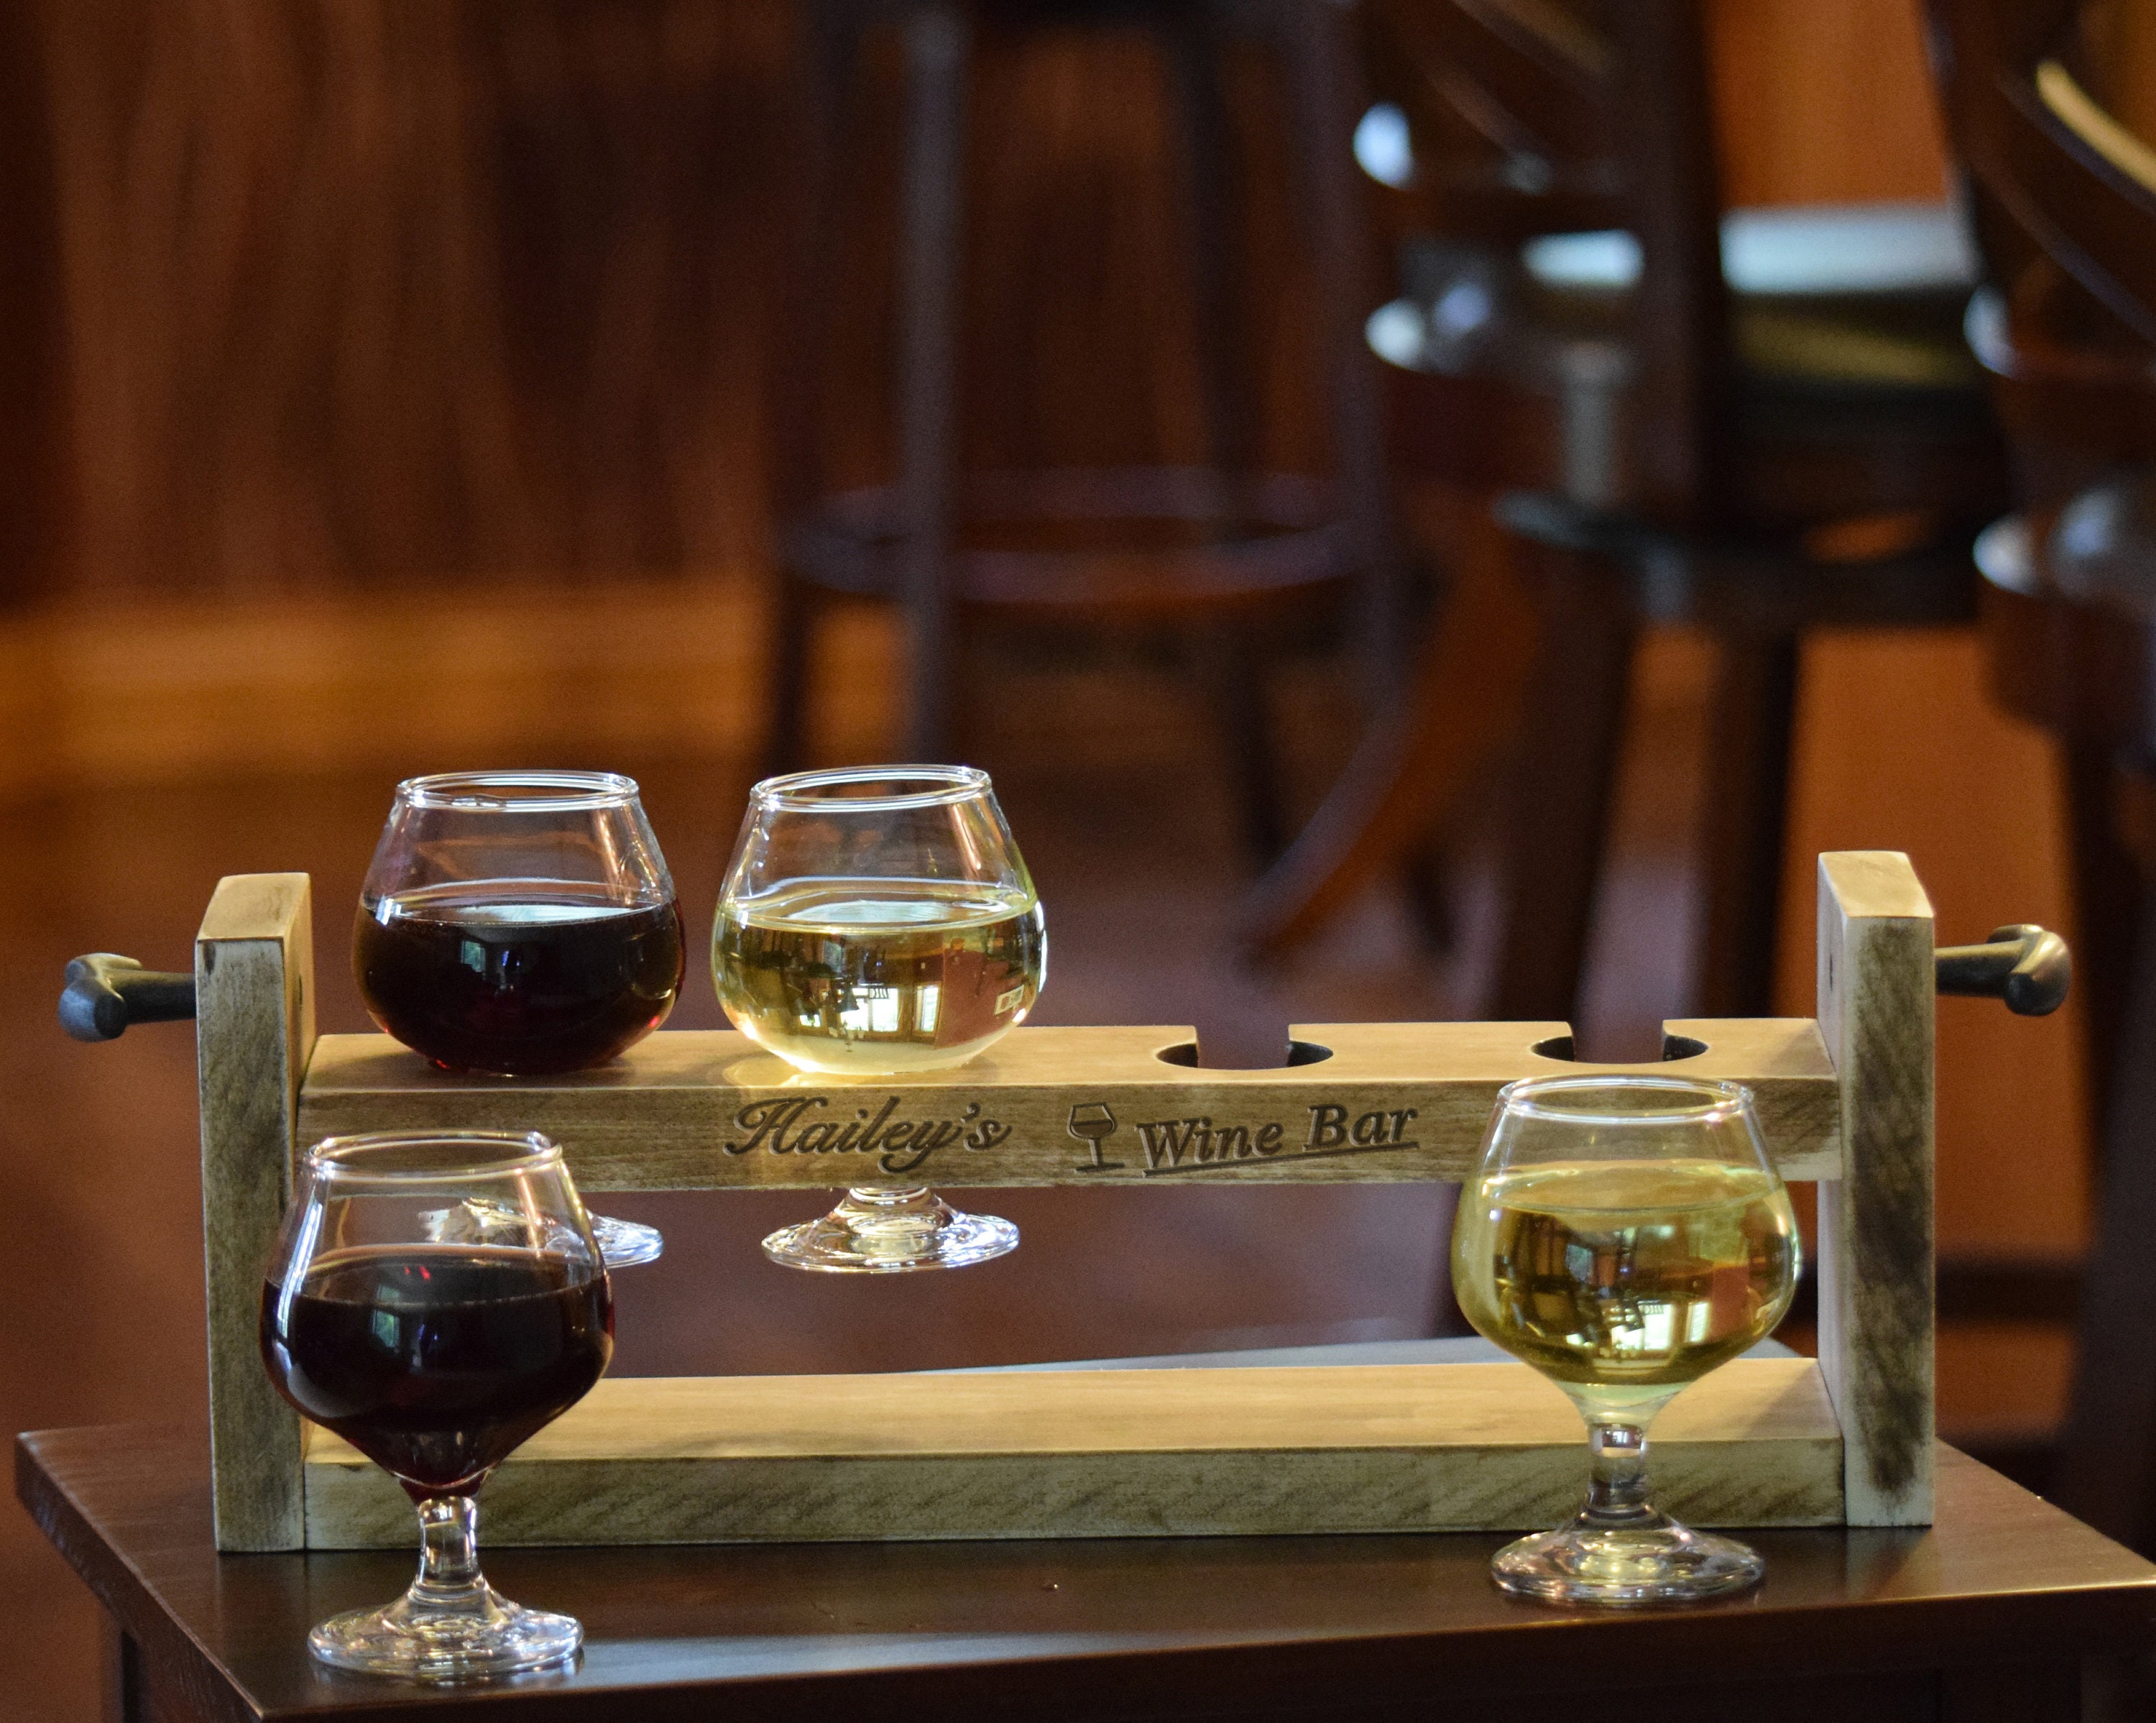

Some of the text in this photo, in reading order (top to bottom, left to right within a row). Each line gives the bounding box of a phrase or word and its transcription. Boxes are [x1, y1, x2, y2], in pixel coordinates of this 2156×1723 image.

[724, 1095, 1419, 1174] Hailey's Wine Bar
